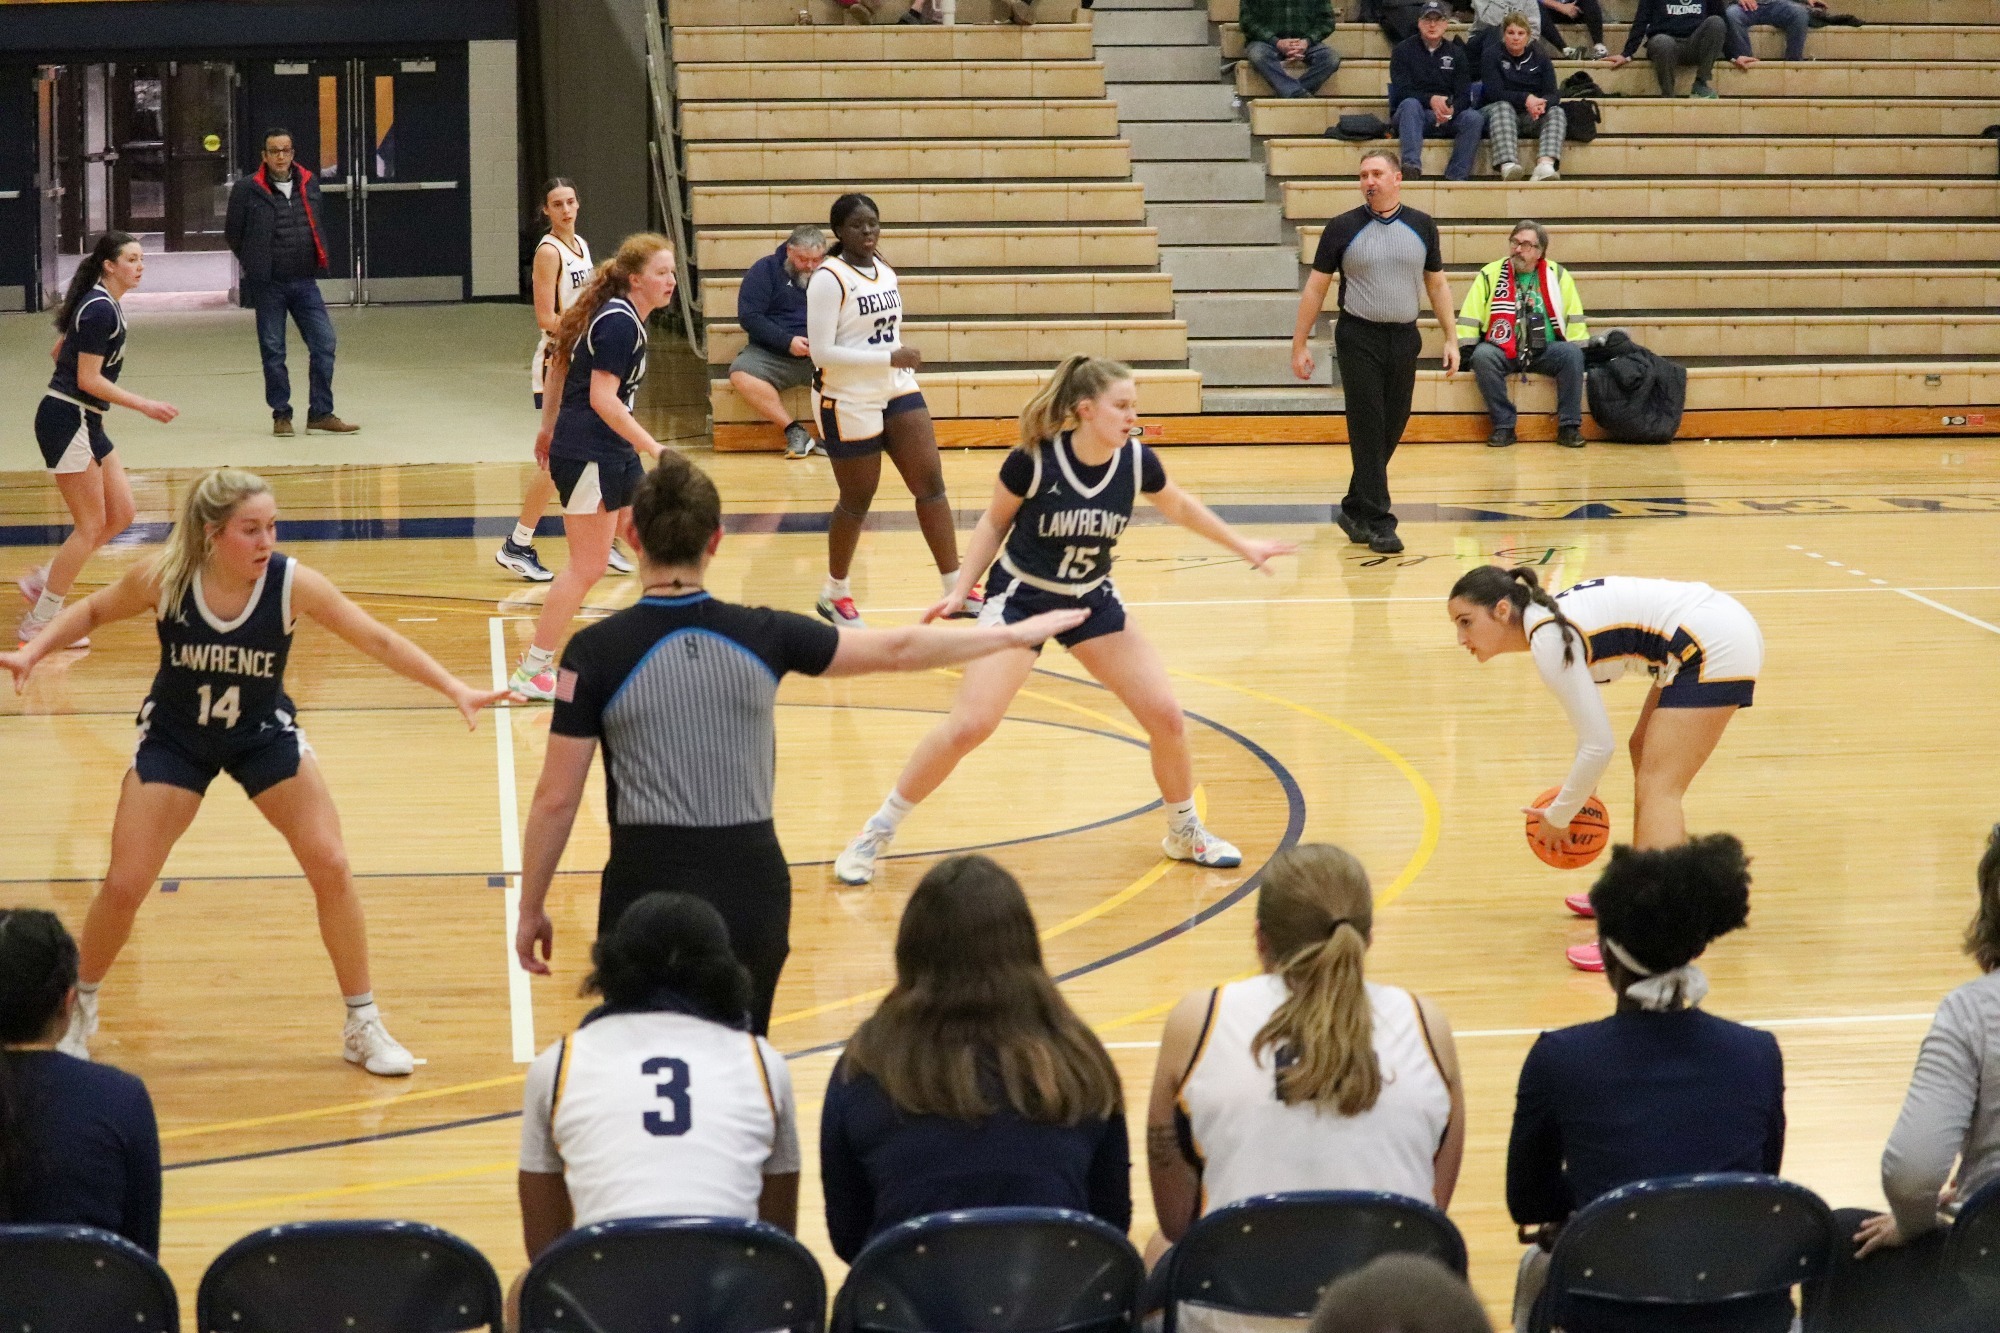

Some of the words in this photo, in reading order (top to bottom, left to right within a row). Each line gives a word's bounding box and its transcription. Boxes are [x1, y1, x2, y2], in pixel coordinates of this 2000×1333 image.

[1666, 4, 1702, 15] VIKINGS
[857, 290, 901, 316] BELOIT
[868, 315, 897, 345] 33
[1056, 545, 1100, 579] 15
[170, 643, 276, 678] LAWRENCE
[197, 684, 241, 729] 14
[641, 1056, 692, 1136] 3
